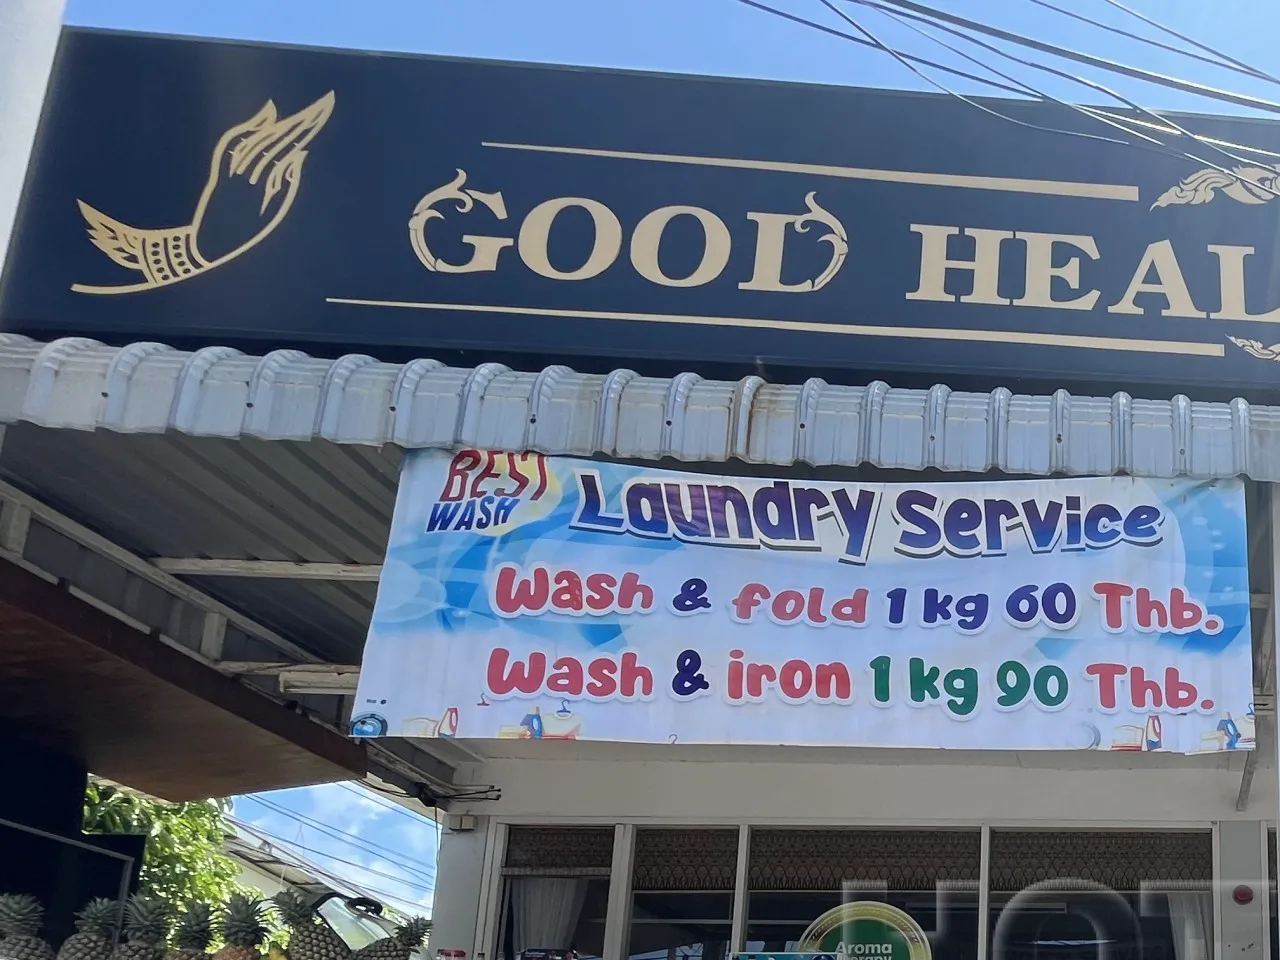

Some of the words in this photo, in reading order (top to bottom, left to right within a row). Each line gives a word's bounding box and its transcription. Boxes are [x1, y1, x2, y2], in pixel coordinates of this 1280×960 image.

[408, 168, 849, 292] GOOD
[426, 494, 521, 533] WASH
[571, 473, 880, 564] Laundry
[892, 485, 1166, 558] Service
[495, 567, 653, 616] Wash
[672, 577, 709, 614] &
[731, 581, 867, 626] fold
[887, 587, 905, 623] 1
[919, 587, 989, 631] kg
[1005, 583, 1076, 624] 60
[1095, 581, 1222, 634] Thb.
[487, 647, 652, 697] Wash
[672, 649, 709, 694] &
[728, 649, 851, 702] iron
[870, 656, 891, 702] 1
[909, 656, 979, 716] kg
[997, 660, 1068, 705] 90
[1085, 661, 1215, 713] Thb.
